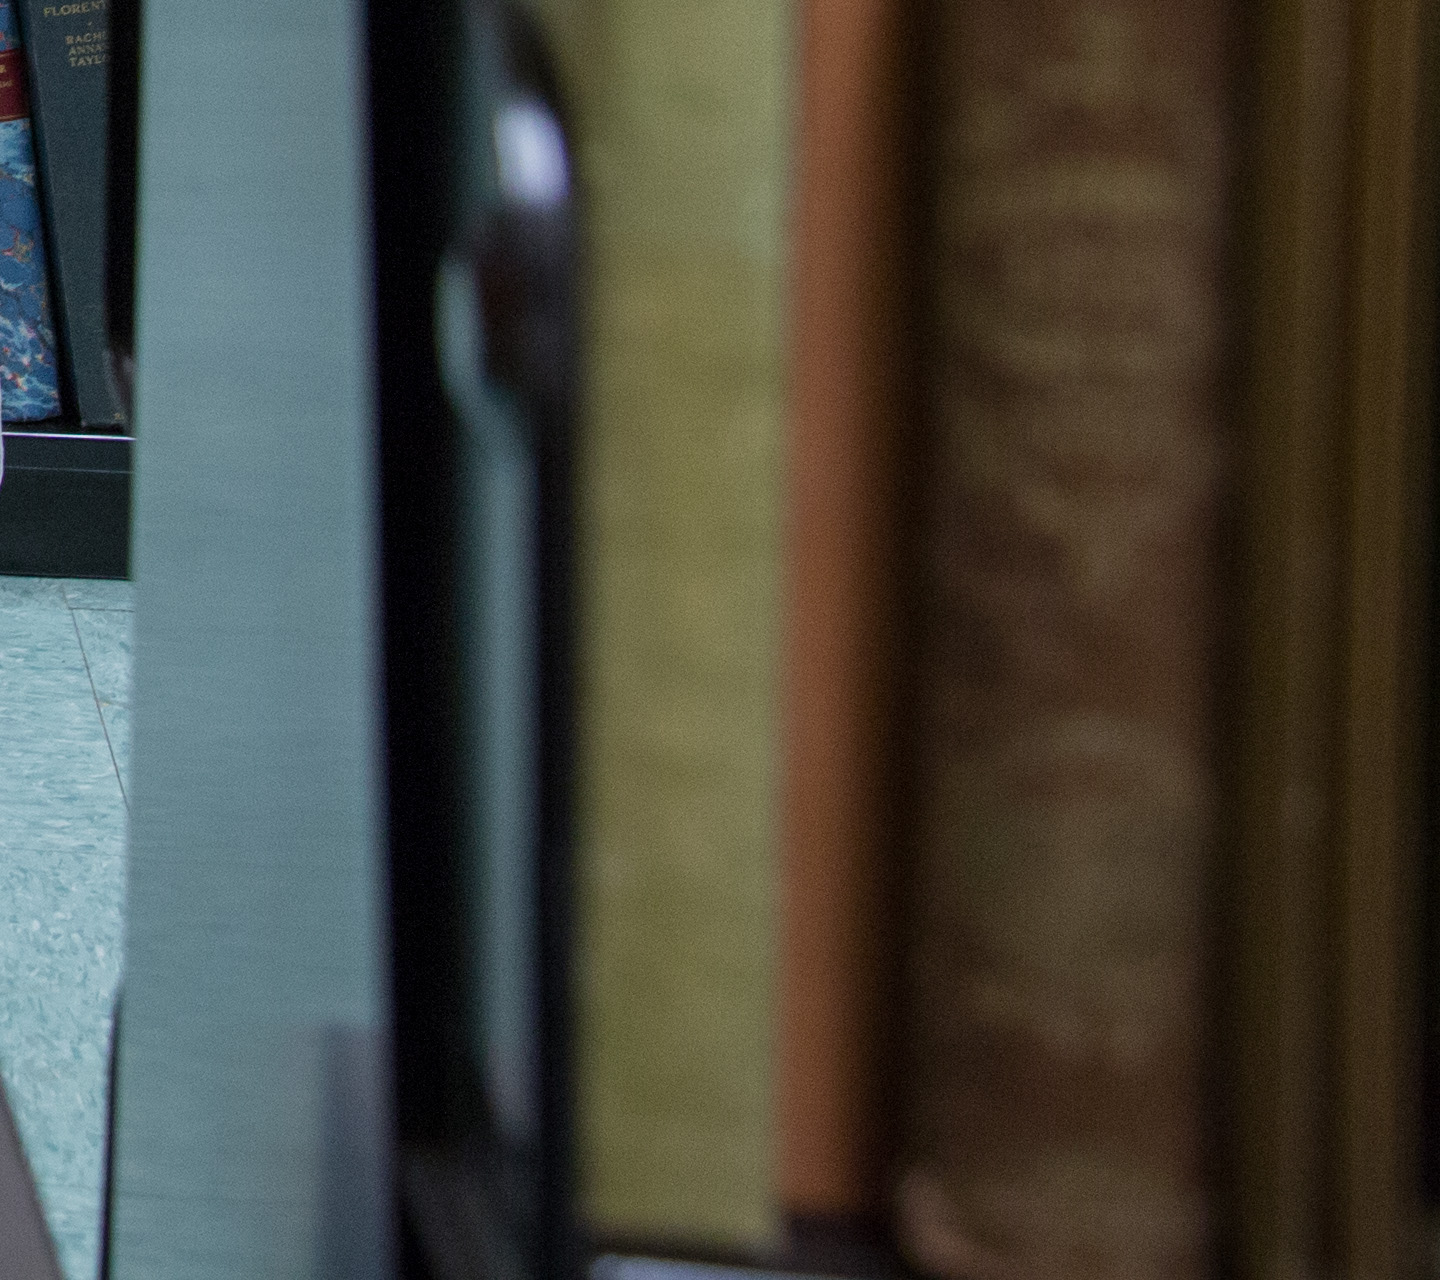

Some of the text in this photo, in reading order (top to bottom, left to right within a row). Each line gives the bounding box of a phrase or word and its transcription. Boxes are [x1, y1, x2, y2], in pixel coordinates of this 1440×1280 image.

[43, 0, 107, 18] FLORENT
[65, 30, 108, 45] RACH
[68, 43, 108, 56] ANNA
[68, 53, 107, 68] TAYL
